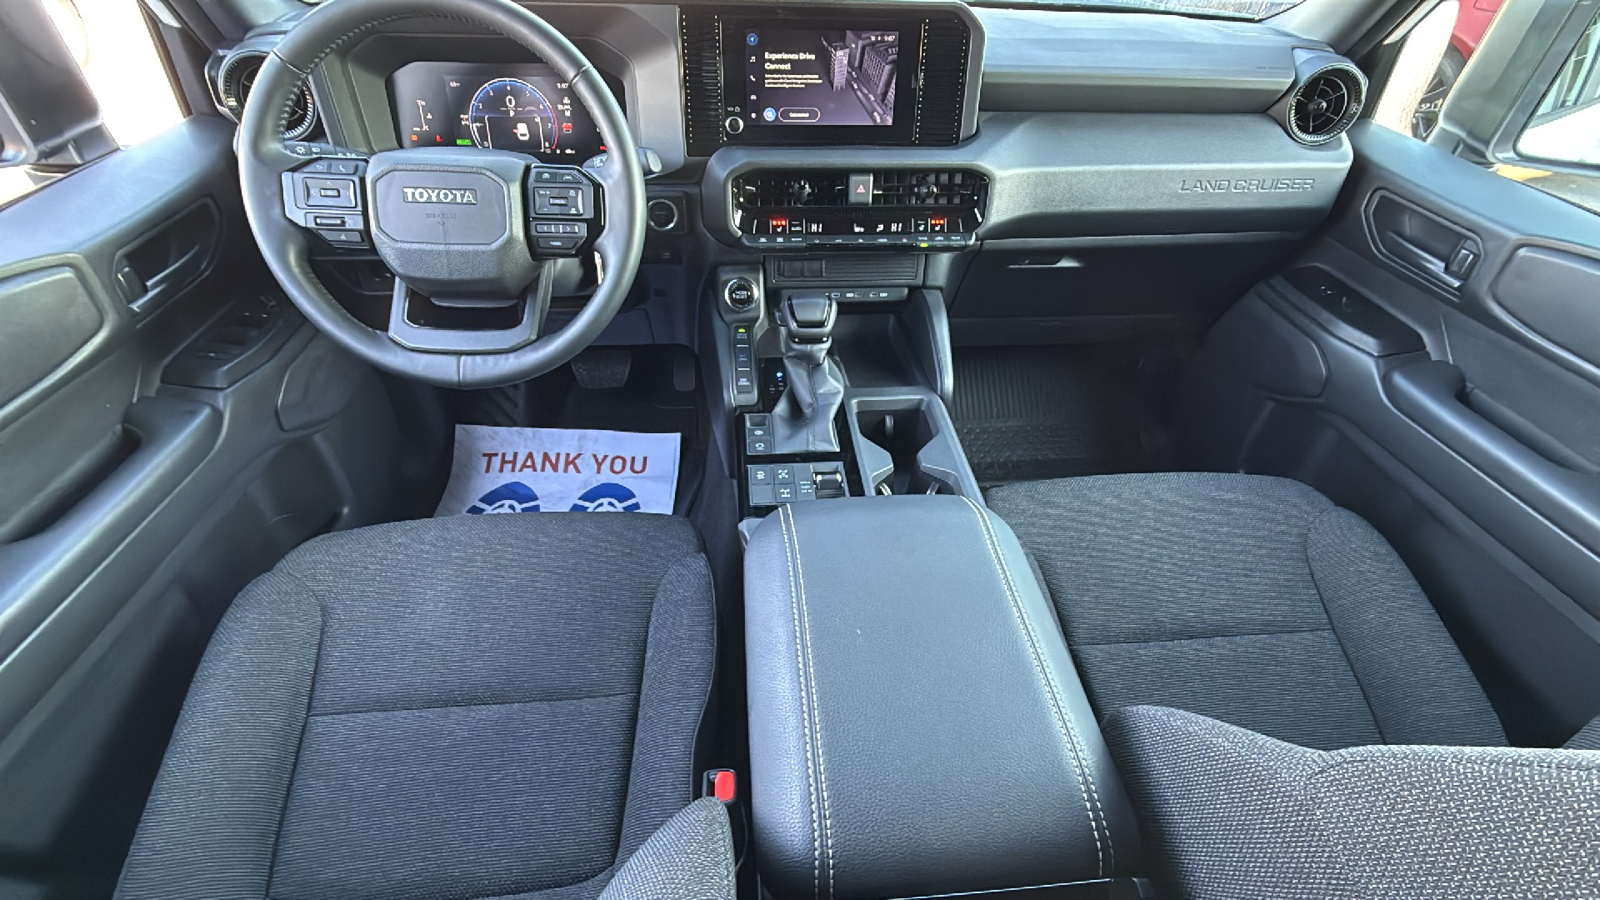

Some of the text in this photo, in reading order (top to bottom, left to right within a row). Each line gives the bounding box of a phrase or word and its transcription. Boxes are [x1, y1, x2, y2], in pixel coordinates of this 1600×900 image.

[764, 51, 816, 60] Experience Drive
[764, 62, 792, 70] Connect
[506, 95, 516, 107] 0
[1178, 178, 1315, 193] LAND CRUISER
[402, 187, 477, 204] TOYOTA
[482, 451, 648, 475] THANK YOU
